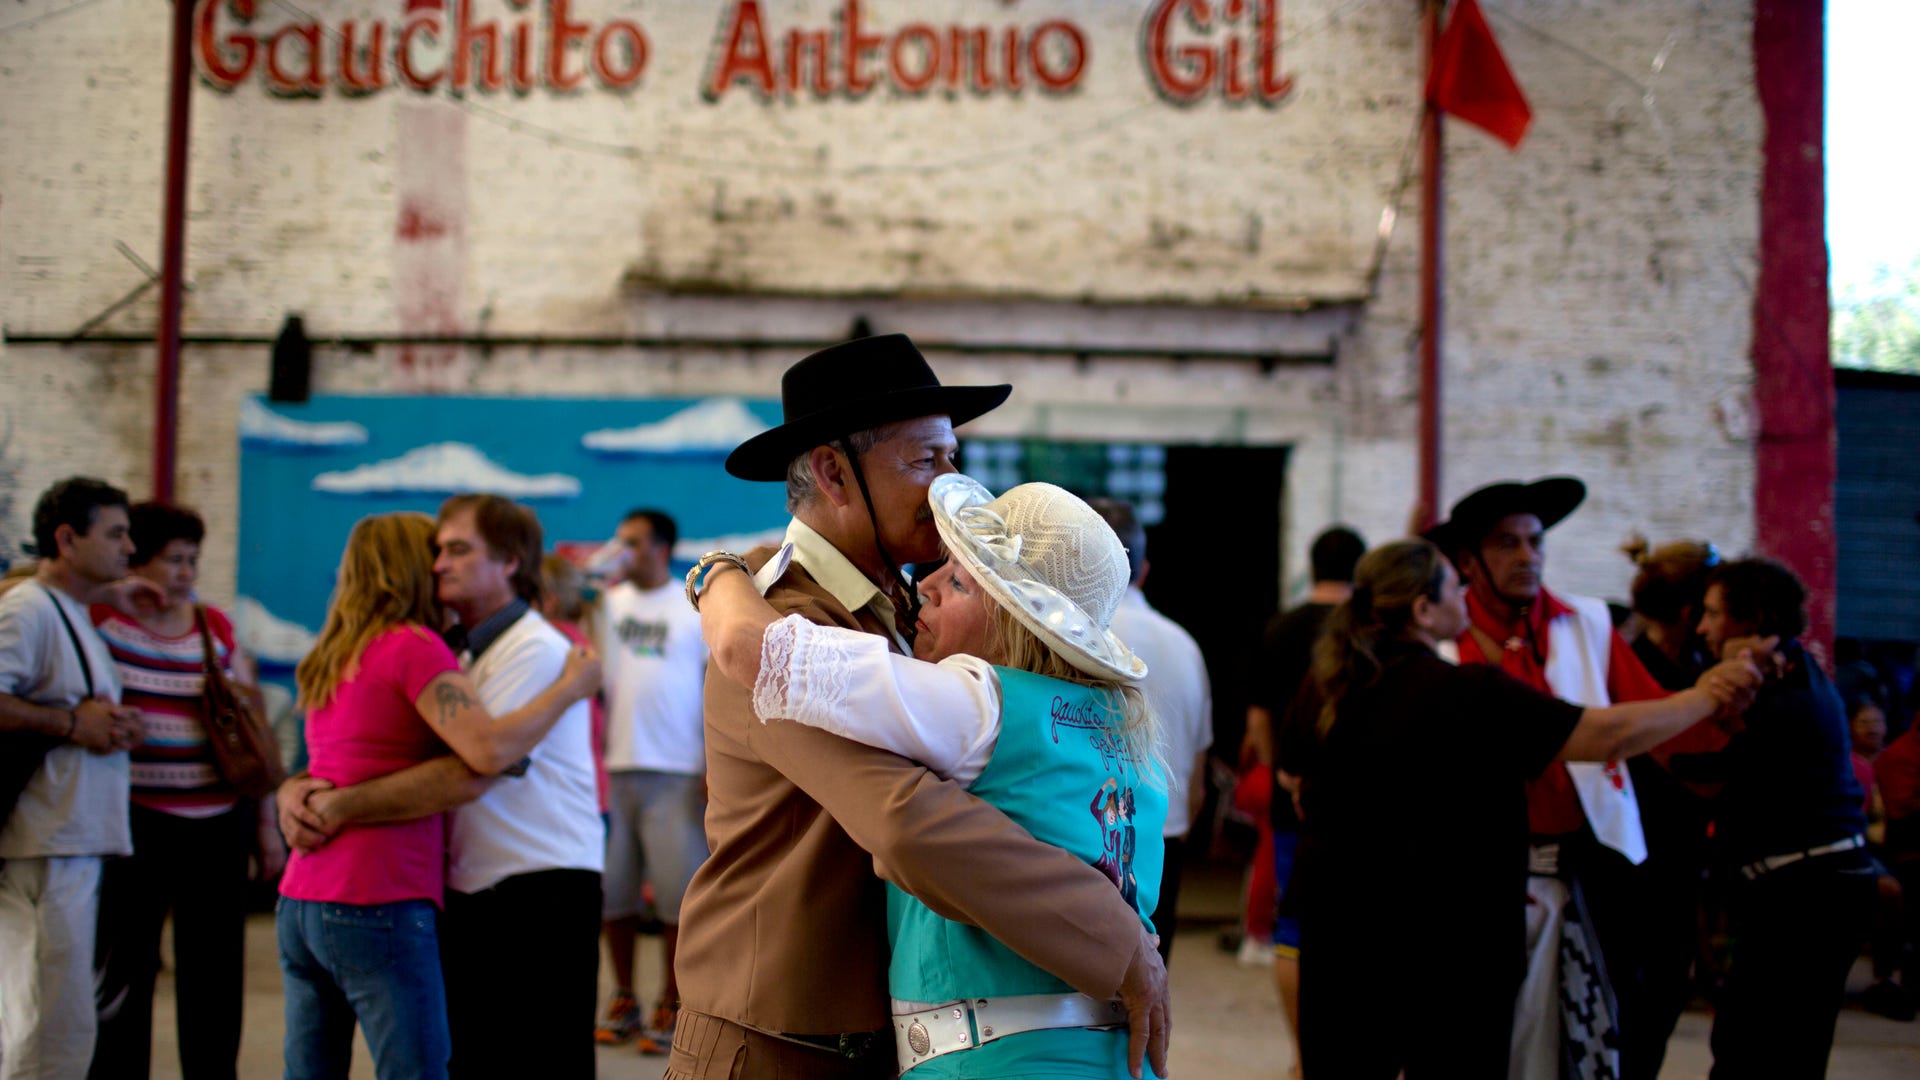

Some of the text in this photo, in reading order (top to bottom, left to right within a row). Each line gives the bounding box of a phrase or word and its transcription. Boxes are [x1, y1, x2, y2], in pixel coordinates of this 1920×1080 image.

[193, 0, 1295, 106] Gauchito Antonio Gil
